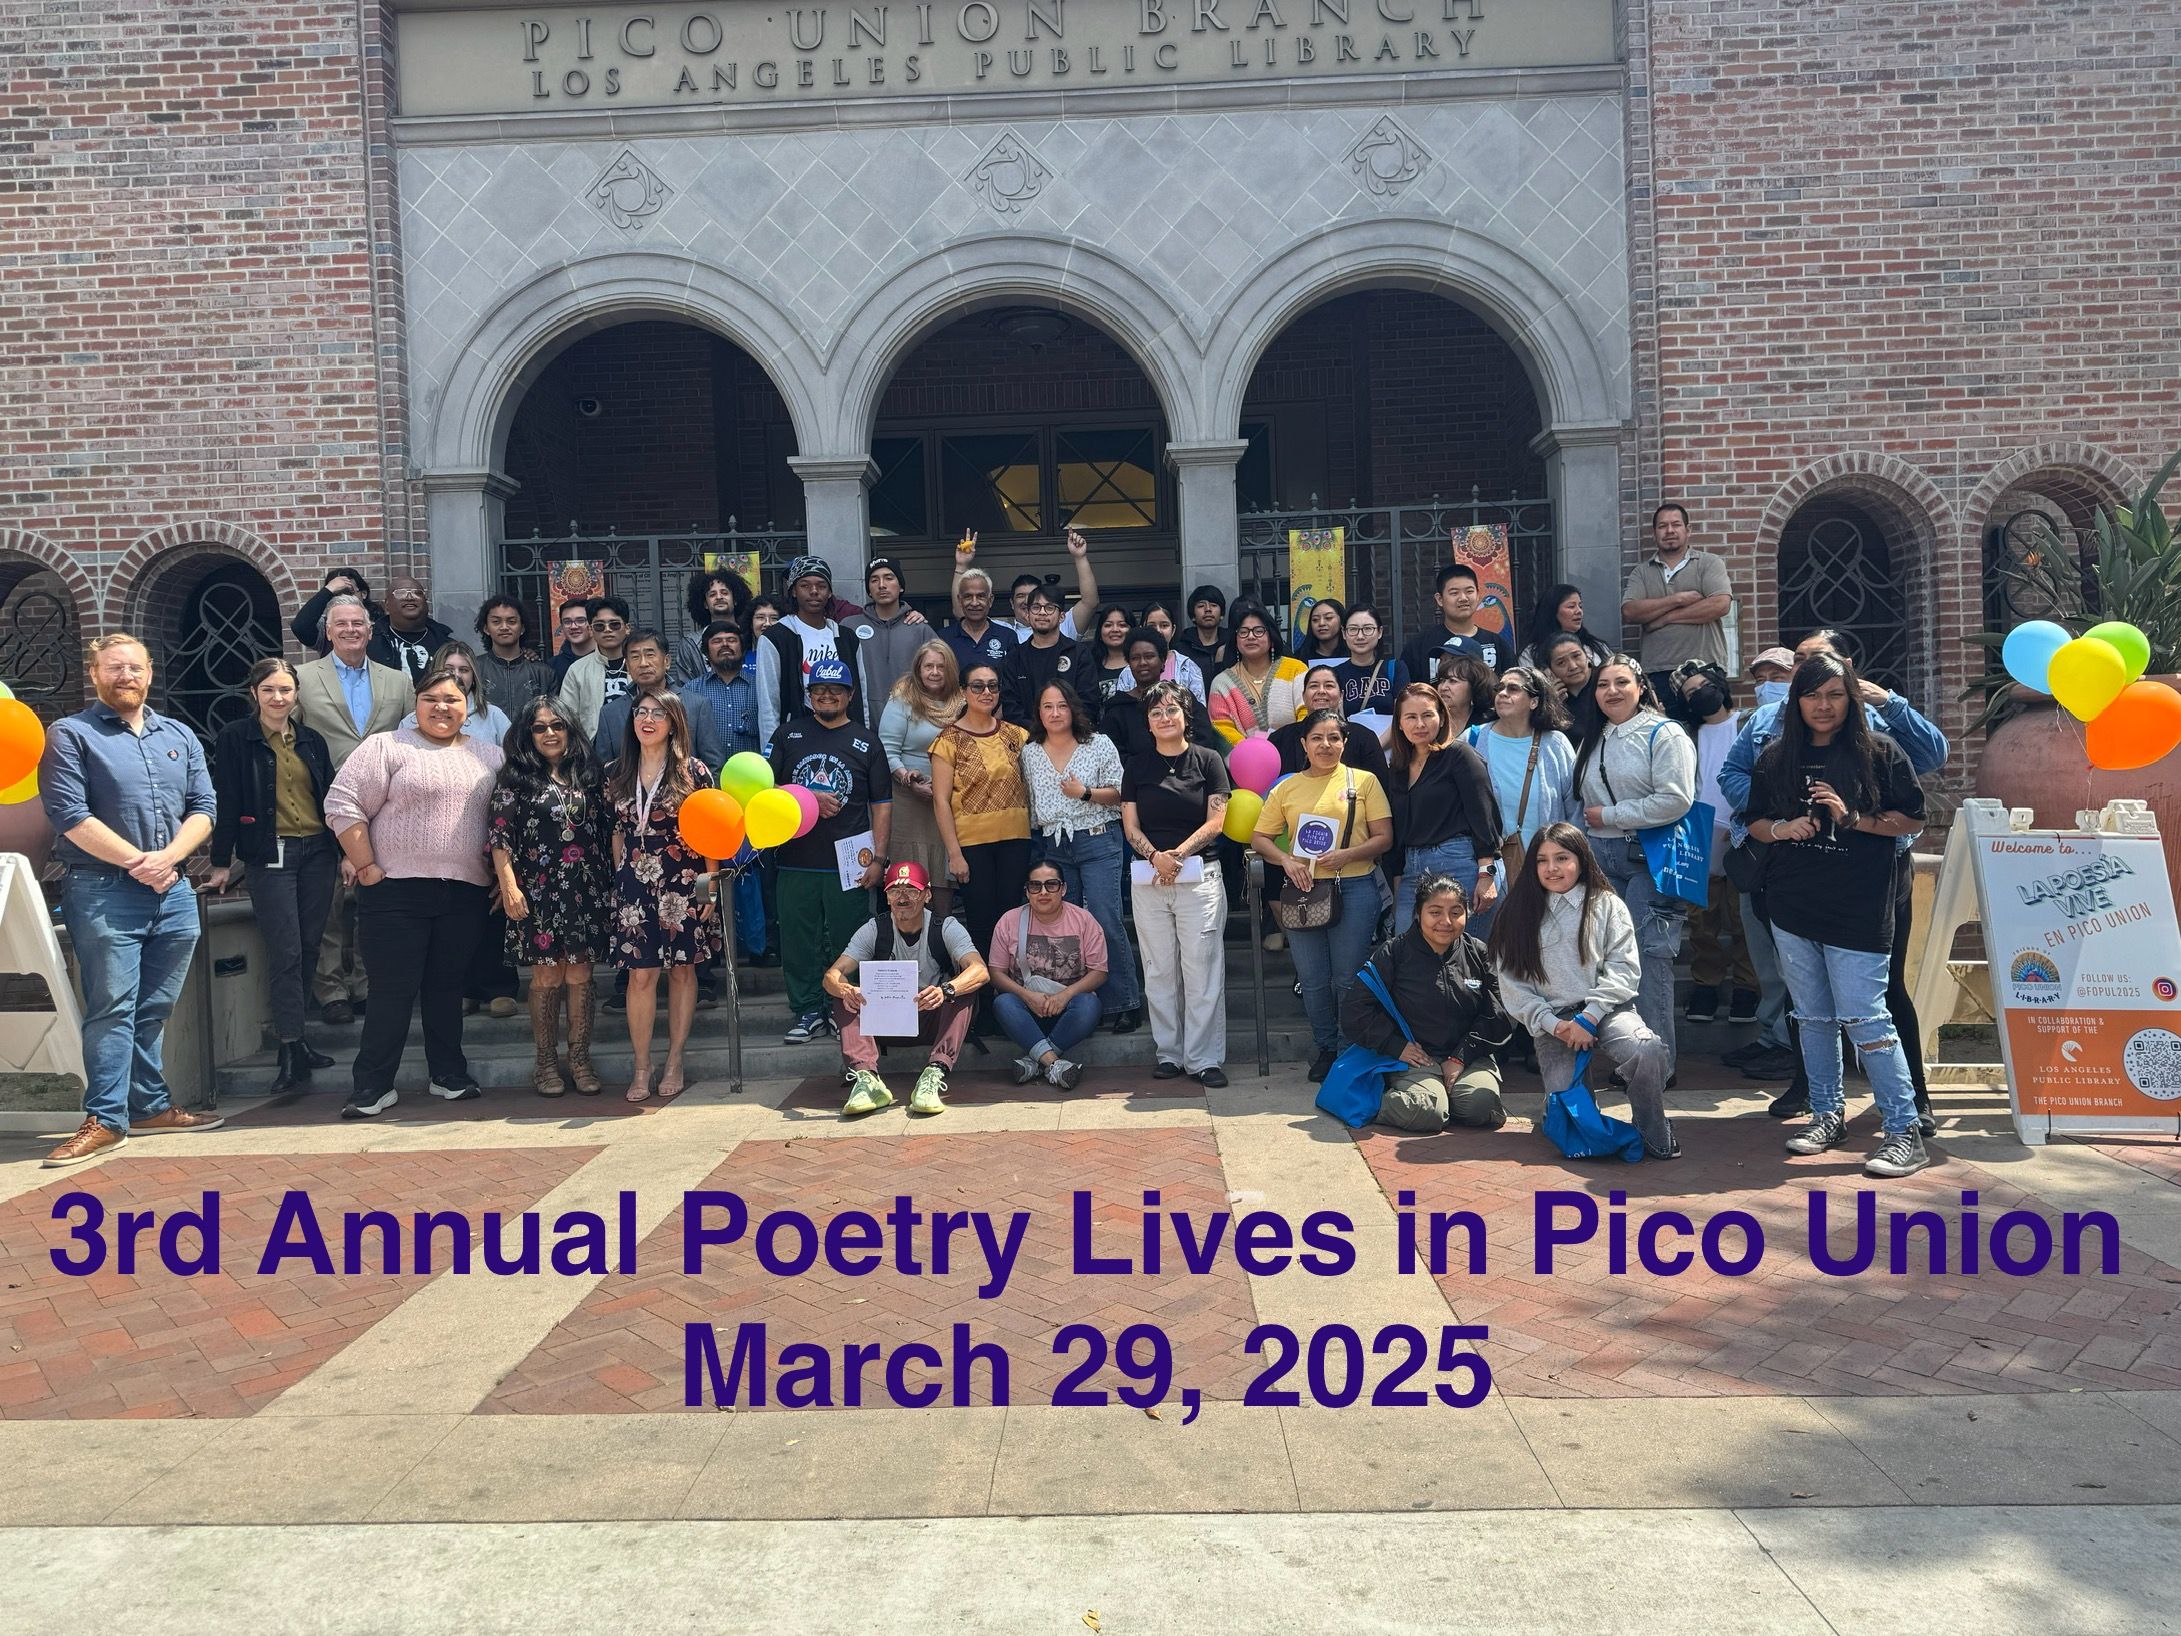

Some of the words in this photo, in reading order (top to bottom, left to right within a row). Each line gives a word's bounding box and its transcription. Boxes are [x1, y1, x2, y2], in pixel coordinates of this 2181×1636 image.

[521, 14, 724, 61] PICO
[785, 0, 1064, 49] UNION
[532, 68, 620, 97] LOS
[673, 55, 921, 92] ANGELES
[974, 43, 1178, 79] PUBLIC
[1230, 29, 1476, 67] LIBRARY
[816, 665, 843, 678] Cabal
[1346, 677, 1390, 701] GAP
[852, 738, 869, 753] ES
[1991, 841, 2054, 854] Welcome
[2053, 886, 2112, 918] VIVE
[2044, 929, 2065, 948] EN
[2067, 918, 2102, 940] PICO
[2105, 902, 2152, 928] UNION
[2081, 974, 2113, 982] FOLLOW
[2077, 986, 2141, 998] @FOPUL2025
[2028, 1016, 2036, 1024] IN
[2039, 1016, 2096, 1025] COLLABORATION
[2099, 1017, 2104, 1026] &
[2037, 1025, 2069, 1034] SUPPORT
[2072, 1026, 2081, 1034] OF
[2084, 1026, 2098, 1034] THE
[2064, 1066, 2112, 1074] ANGELES
[2076, 1077, 2120, 1085] LIBRARY
[2034, 1096, 2047, 1105] THE
[2050, 1096, 2067, 1106] PICO
[2069, 1097, 2092, 1106] UNION
[2094, 1097, 2123, 1107] BRANCH
